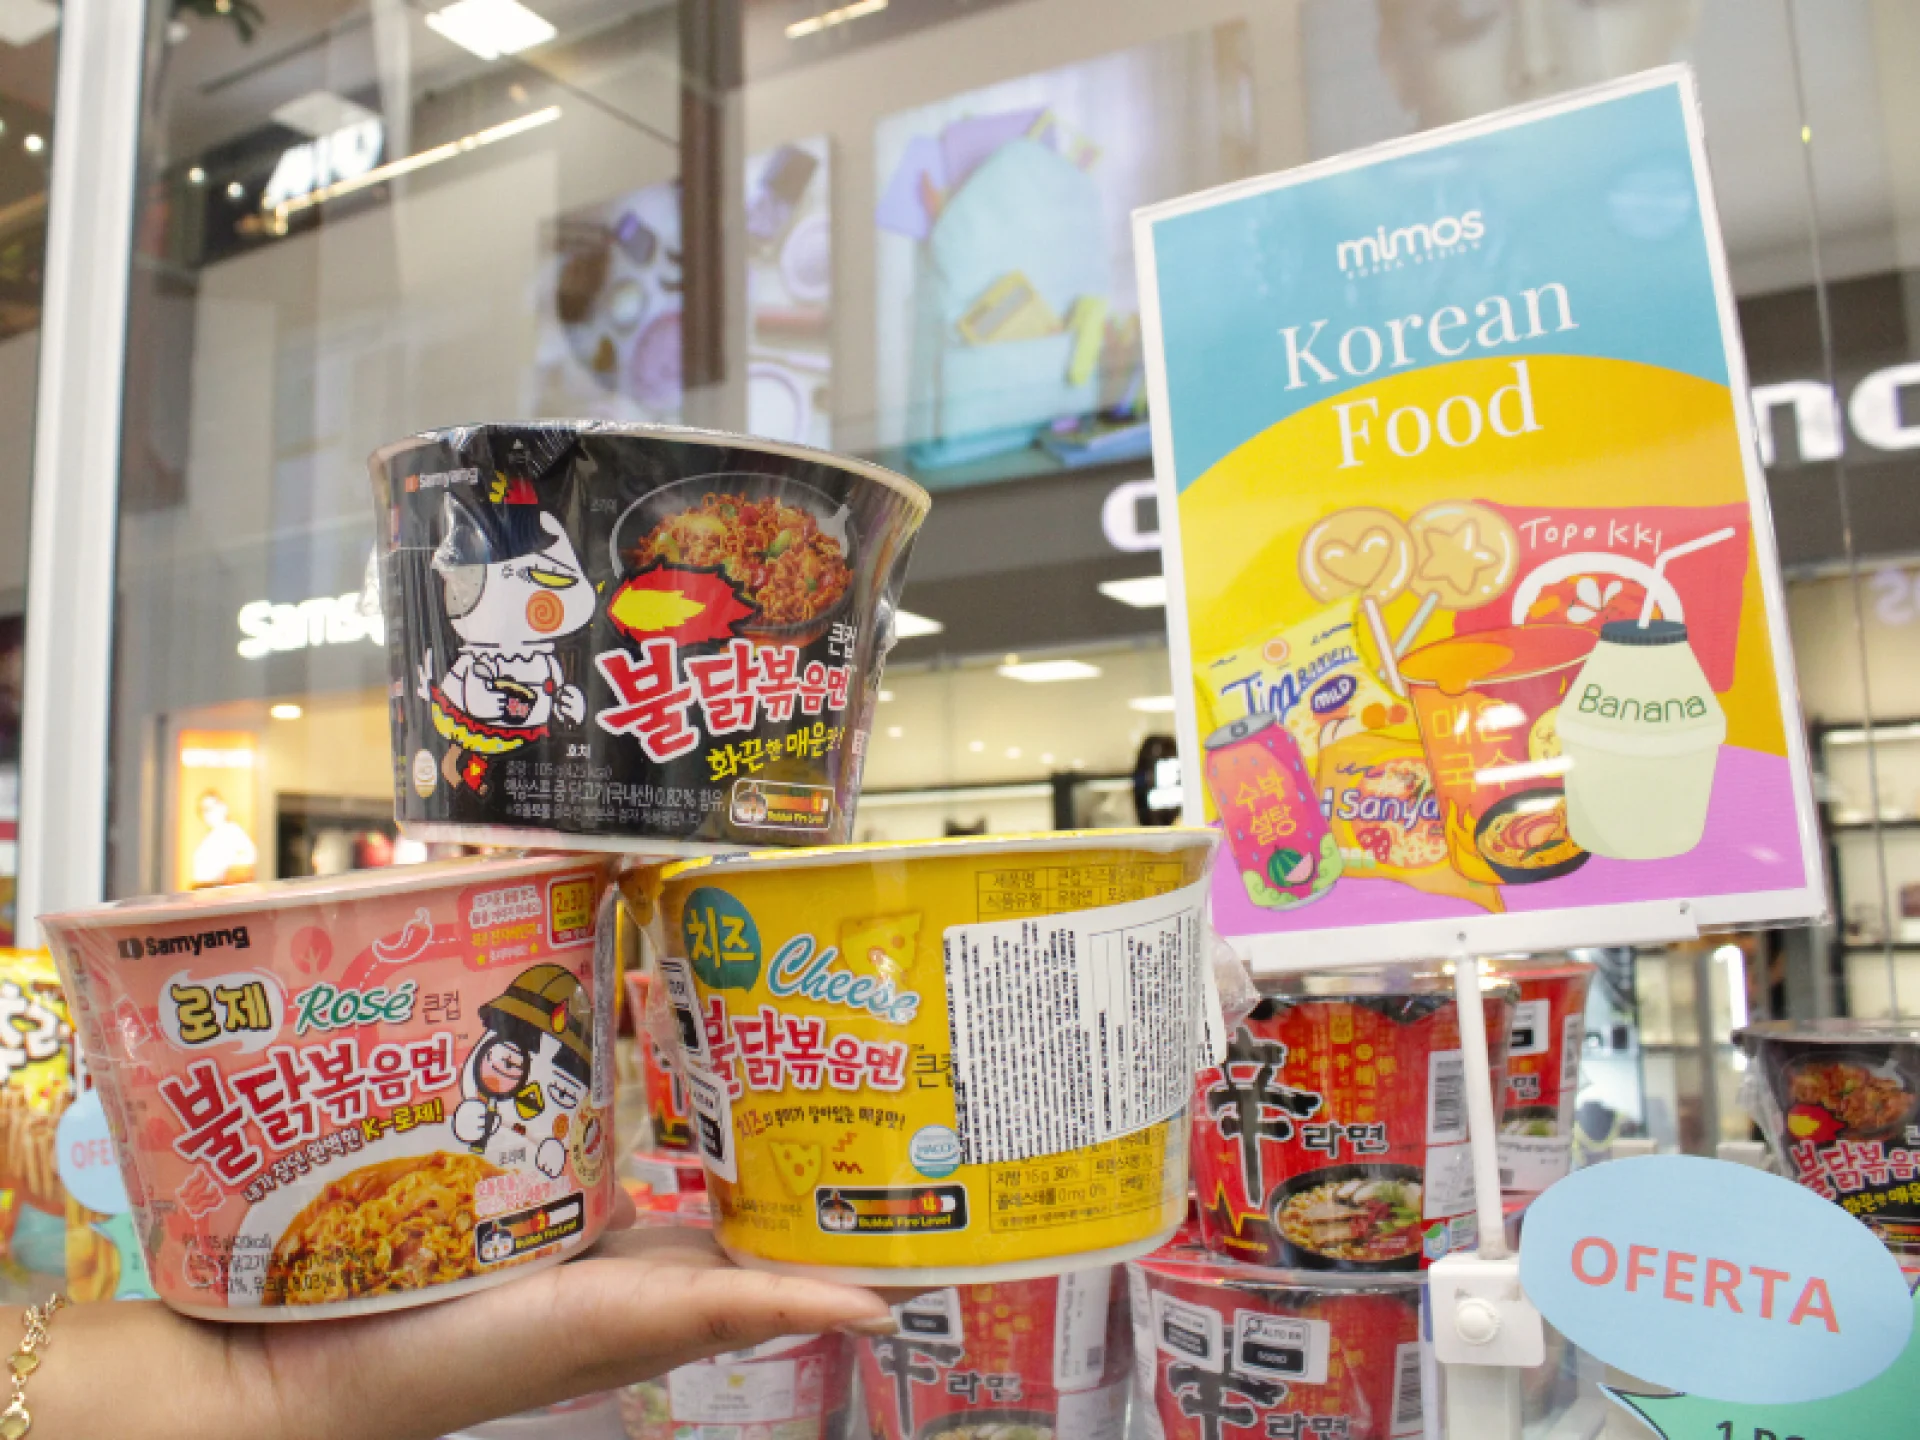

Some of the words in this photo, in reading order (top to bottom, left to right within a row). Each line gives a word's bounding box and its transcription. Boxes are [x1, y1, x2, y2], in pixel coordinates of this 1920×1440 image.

[1336, 210, 1485, 272] mimos
[1278, 280, 1578, 392] Korean
[1331, 360, 1543, 470] Food
[594, 637, 851, 764] 불닭볶음면
[1577, 683, 1708, 723] Banana
[144, 926, 250, 957] Samyang
[687, 907, 755, 968] 치즈
[294, 979, 419, 1036] Rosé
[422, 990, 461, 1024] 큰컵
[767, 934, 921, 1024] Cheese
[169, 981, 272, 1045] 로제
[160, 1031, 457, 1187] 불닭볶음면
[1301, 1119, 1390, 1160] 라면
[1787, 1138, 1920, 1202] 불닭볶음
[1569, 1236, 1842, 1335] OFERTA
